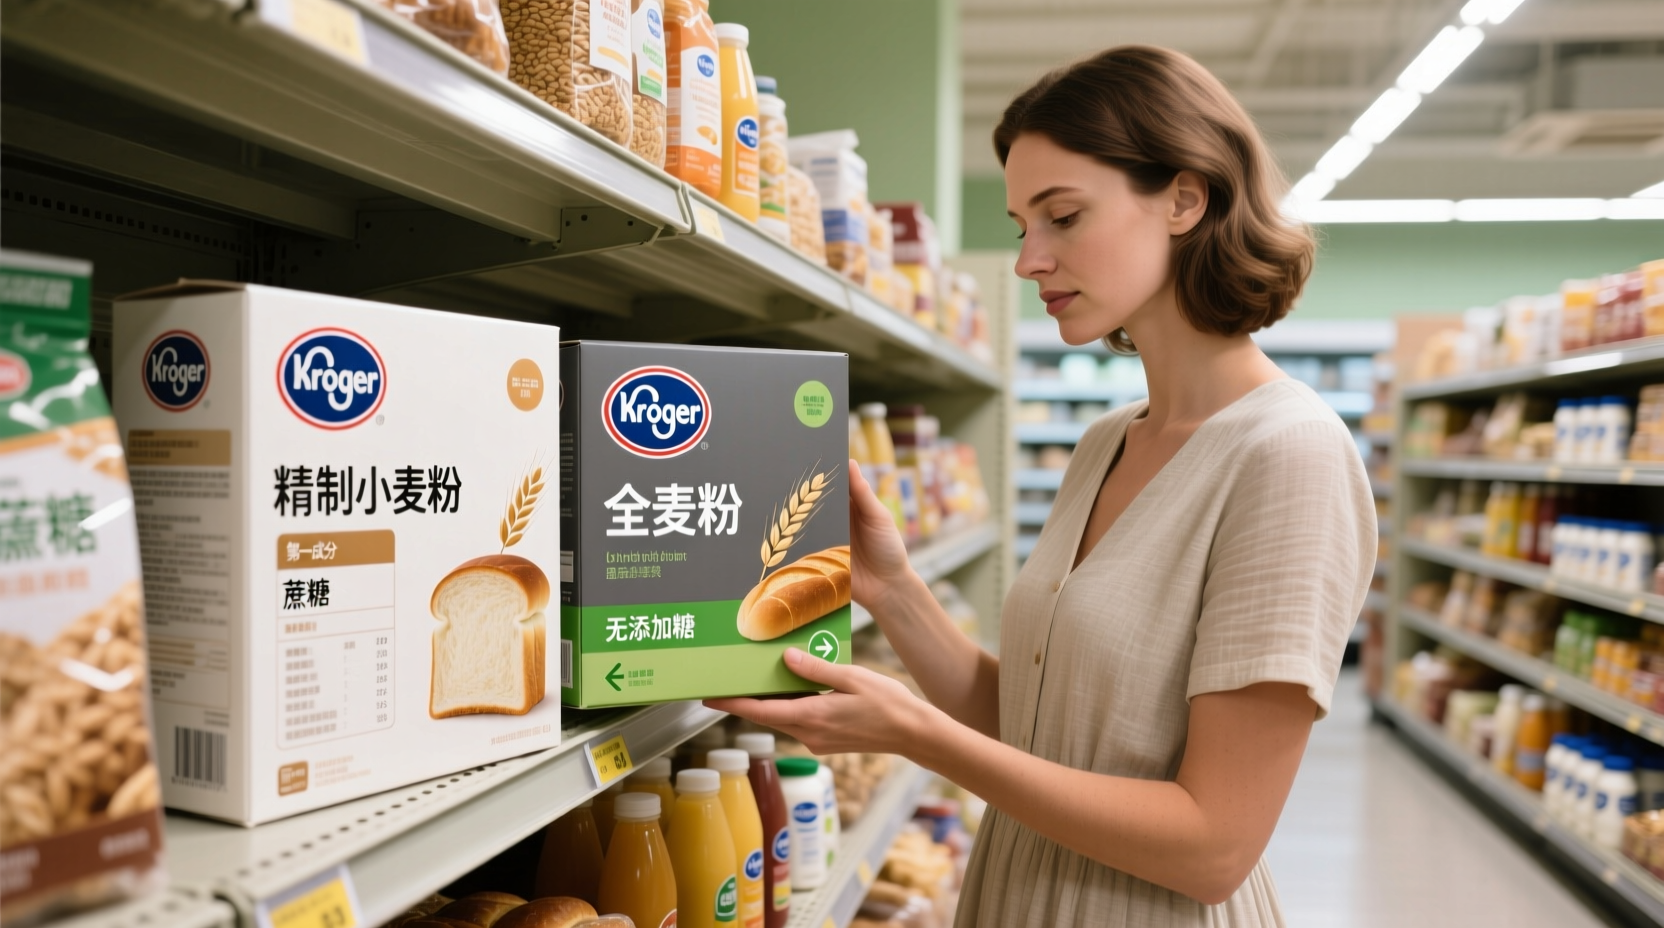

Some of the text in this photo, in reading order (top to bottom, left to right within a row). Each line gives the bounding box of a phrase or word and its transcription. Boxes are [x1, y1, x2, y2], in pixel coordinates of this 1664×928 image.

[152, 347, 205, 397] Kroger
[293, 346, 379, 411] Kroger
[620, 384, 701, 440] Kroger
[274, 464, 462, 517] 精制小麦粉
[603, 482, 743, 537] 全麦粉
[282, 577, 330, 610] 蔗糖
[605, 613, 696, 642] 无添加糖
